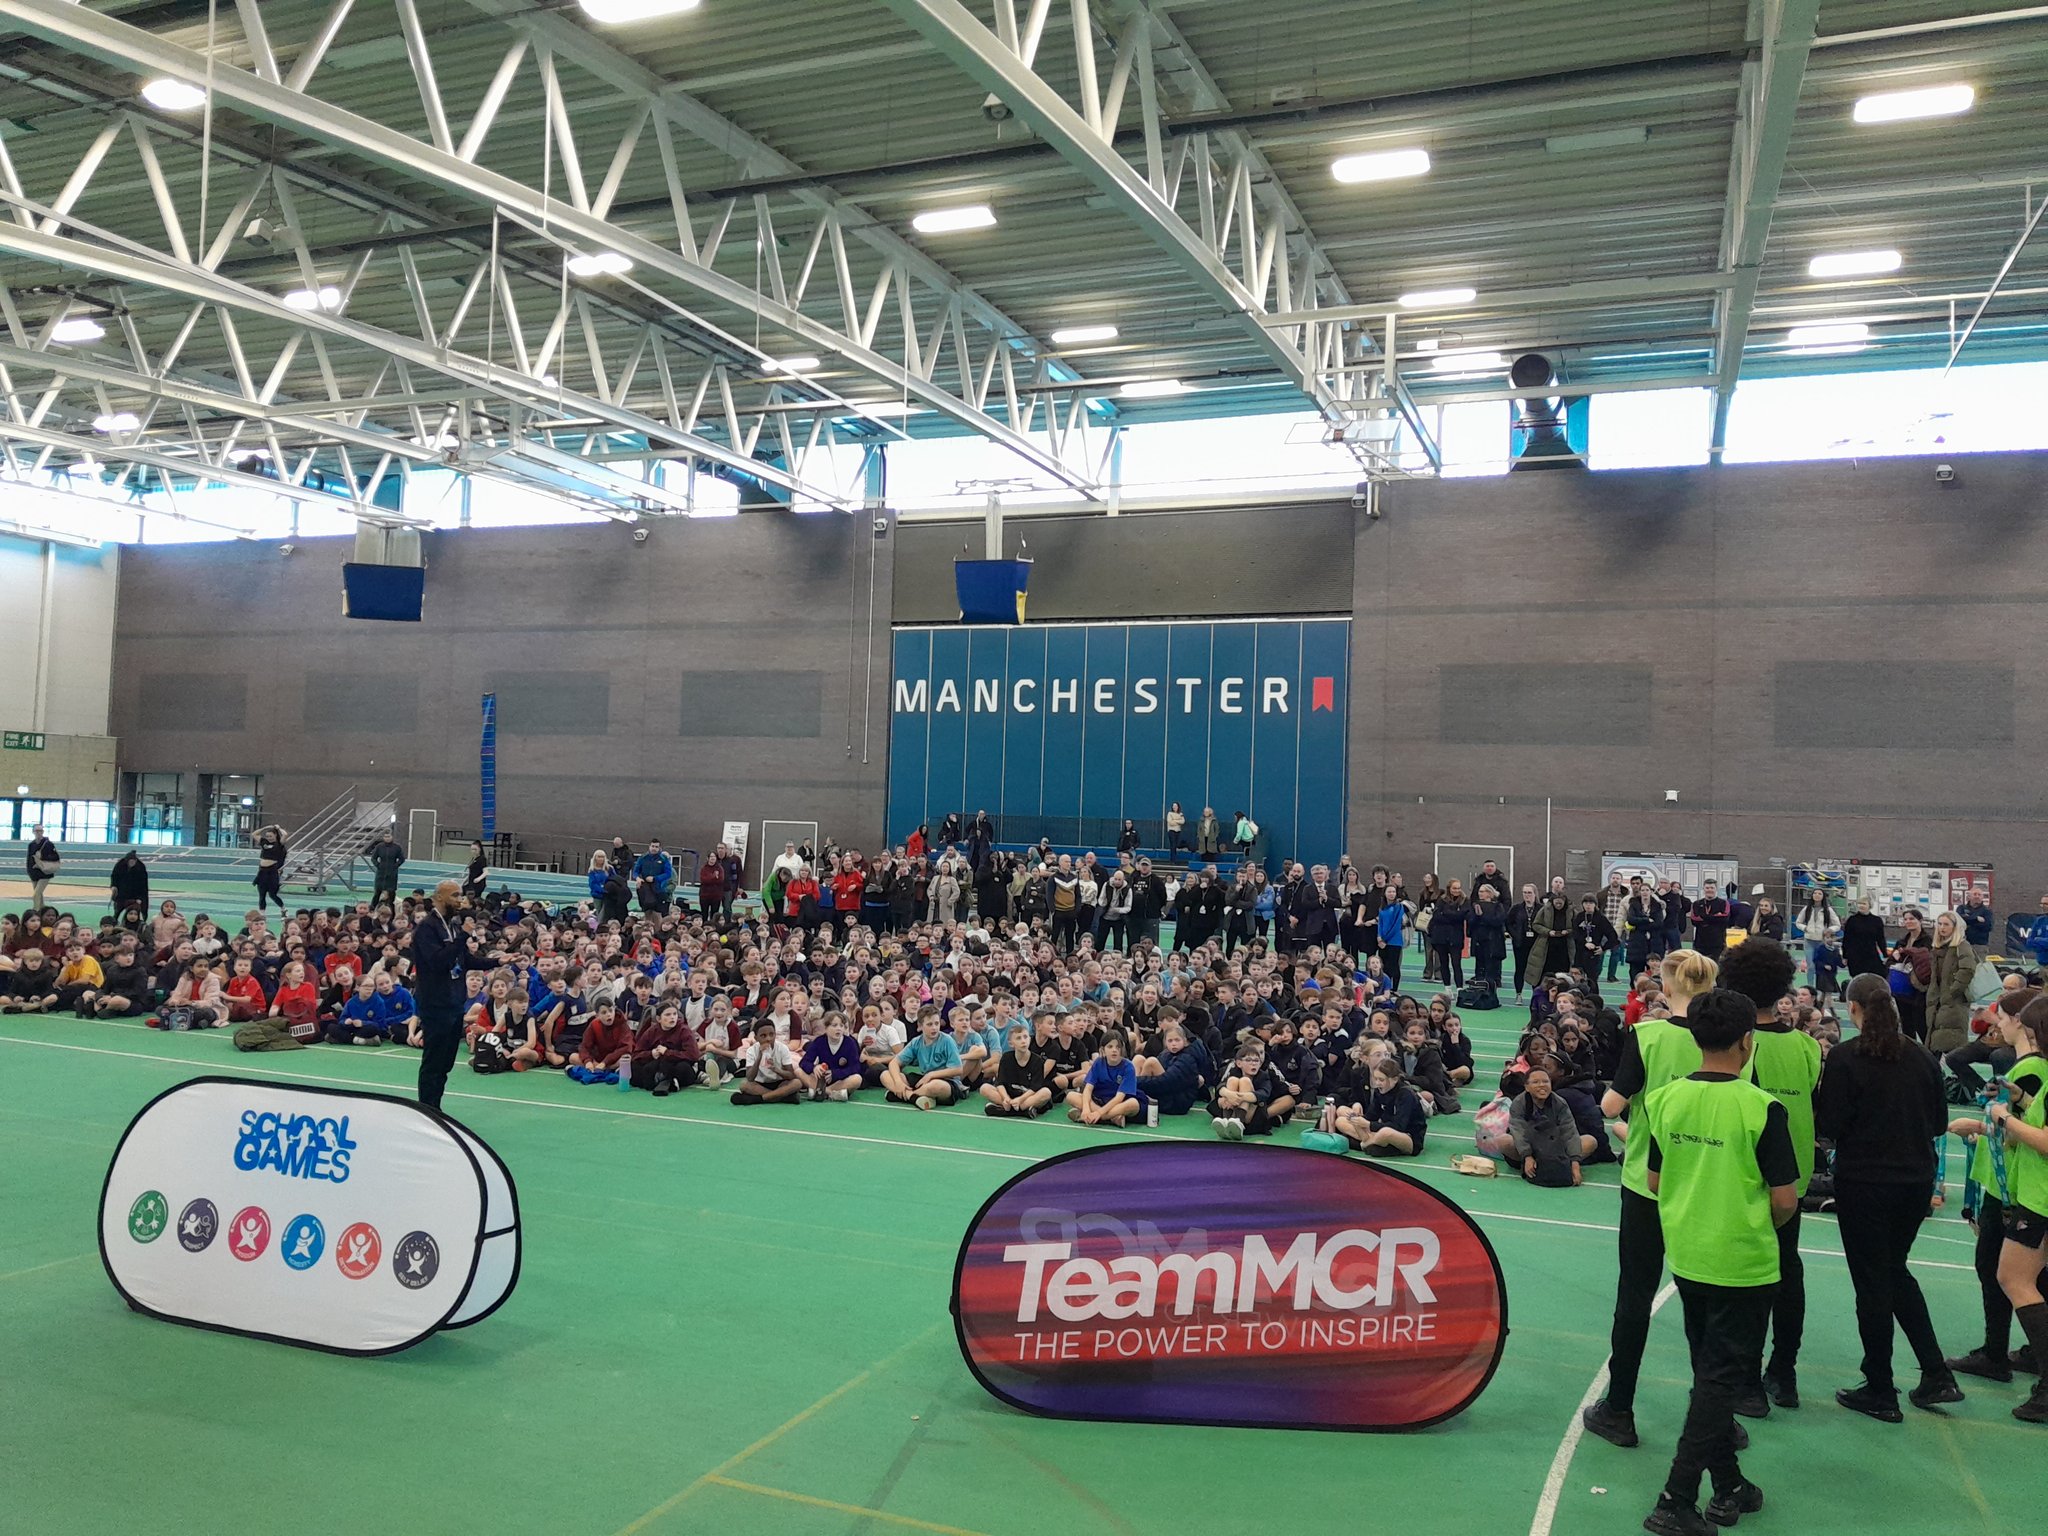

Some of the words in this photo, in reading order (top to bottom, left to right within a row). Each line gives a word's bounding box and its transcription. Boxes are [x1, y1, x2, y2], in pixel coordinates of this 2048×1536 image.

[894, 676, 1289, 714] MANCHESTER
[239, 1109, 357, 1151] SCHOOL
[233, 1137, 351, 1184] GAMES
[1003, 1226, 1441, 1322] TeamMCR
[1014, 1330, 1082, 1361] THE
[1093, 1324, 1228, 1358] POWER
[1241, 1320, 1288, 1351] TO
[1299, 1313, 1439, 1348] INSPIRE
